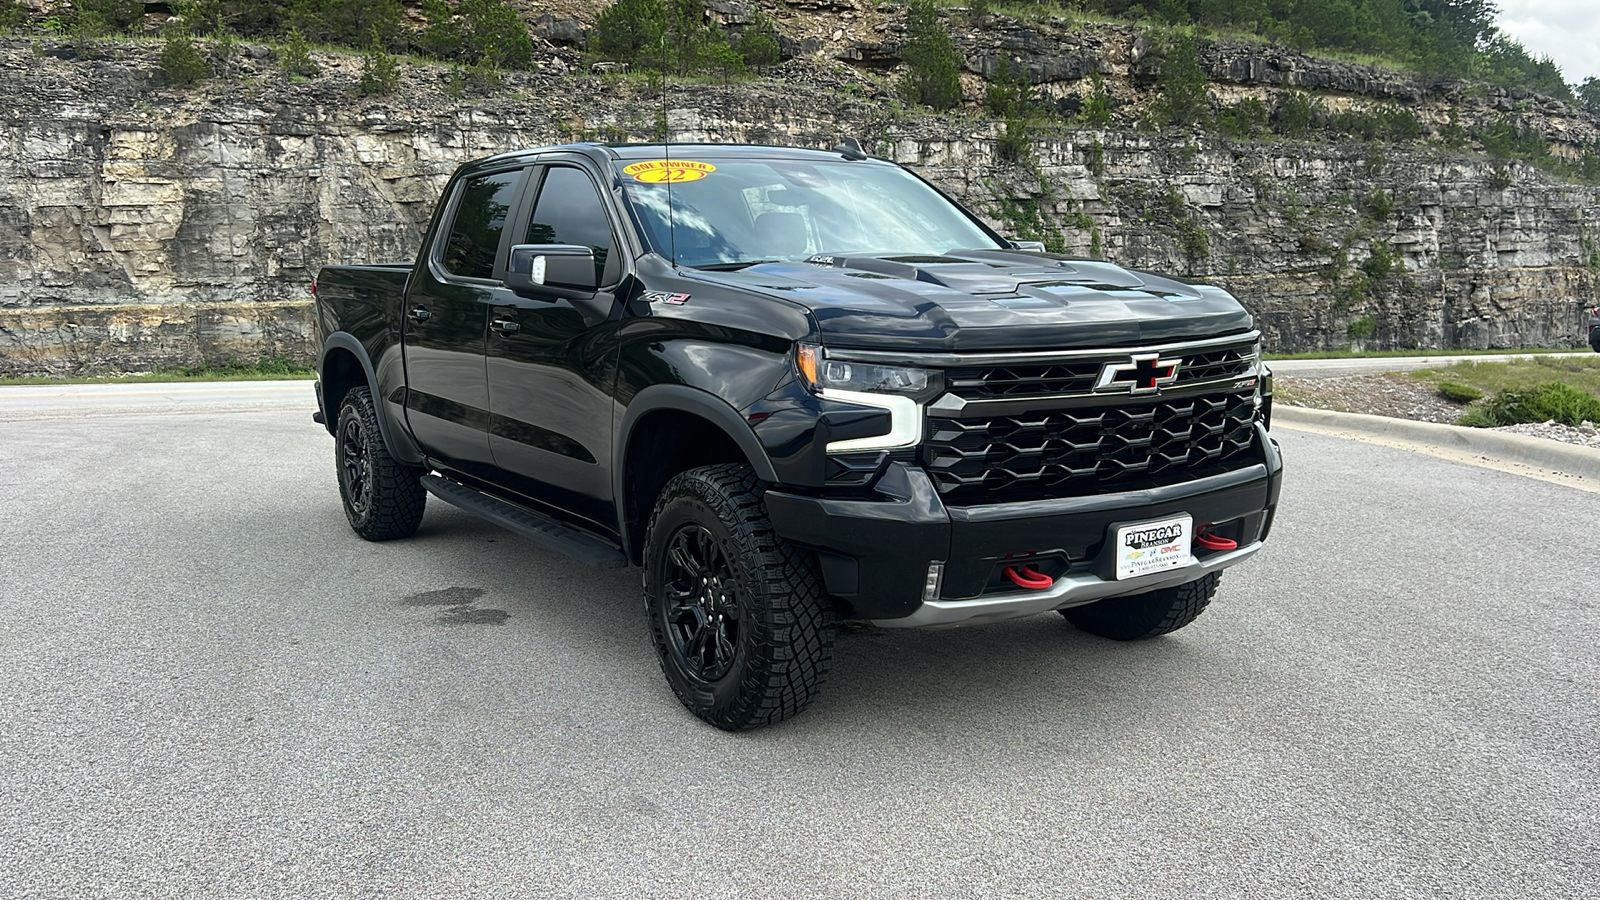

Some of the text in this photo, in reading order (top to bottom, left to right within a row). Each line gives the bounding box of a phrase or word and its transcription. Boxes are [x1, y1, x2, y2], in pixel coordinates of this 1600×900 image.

[630, 161, 707, 171] ONE OWNER
[658, 169, 686, 181] 22
[636, 289, 691, 305] ZR2
[1126, 525, 1182, 546] PINEGAR
[1160, 544, 1181, 554] GMC
